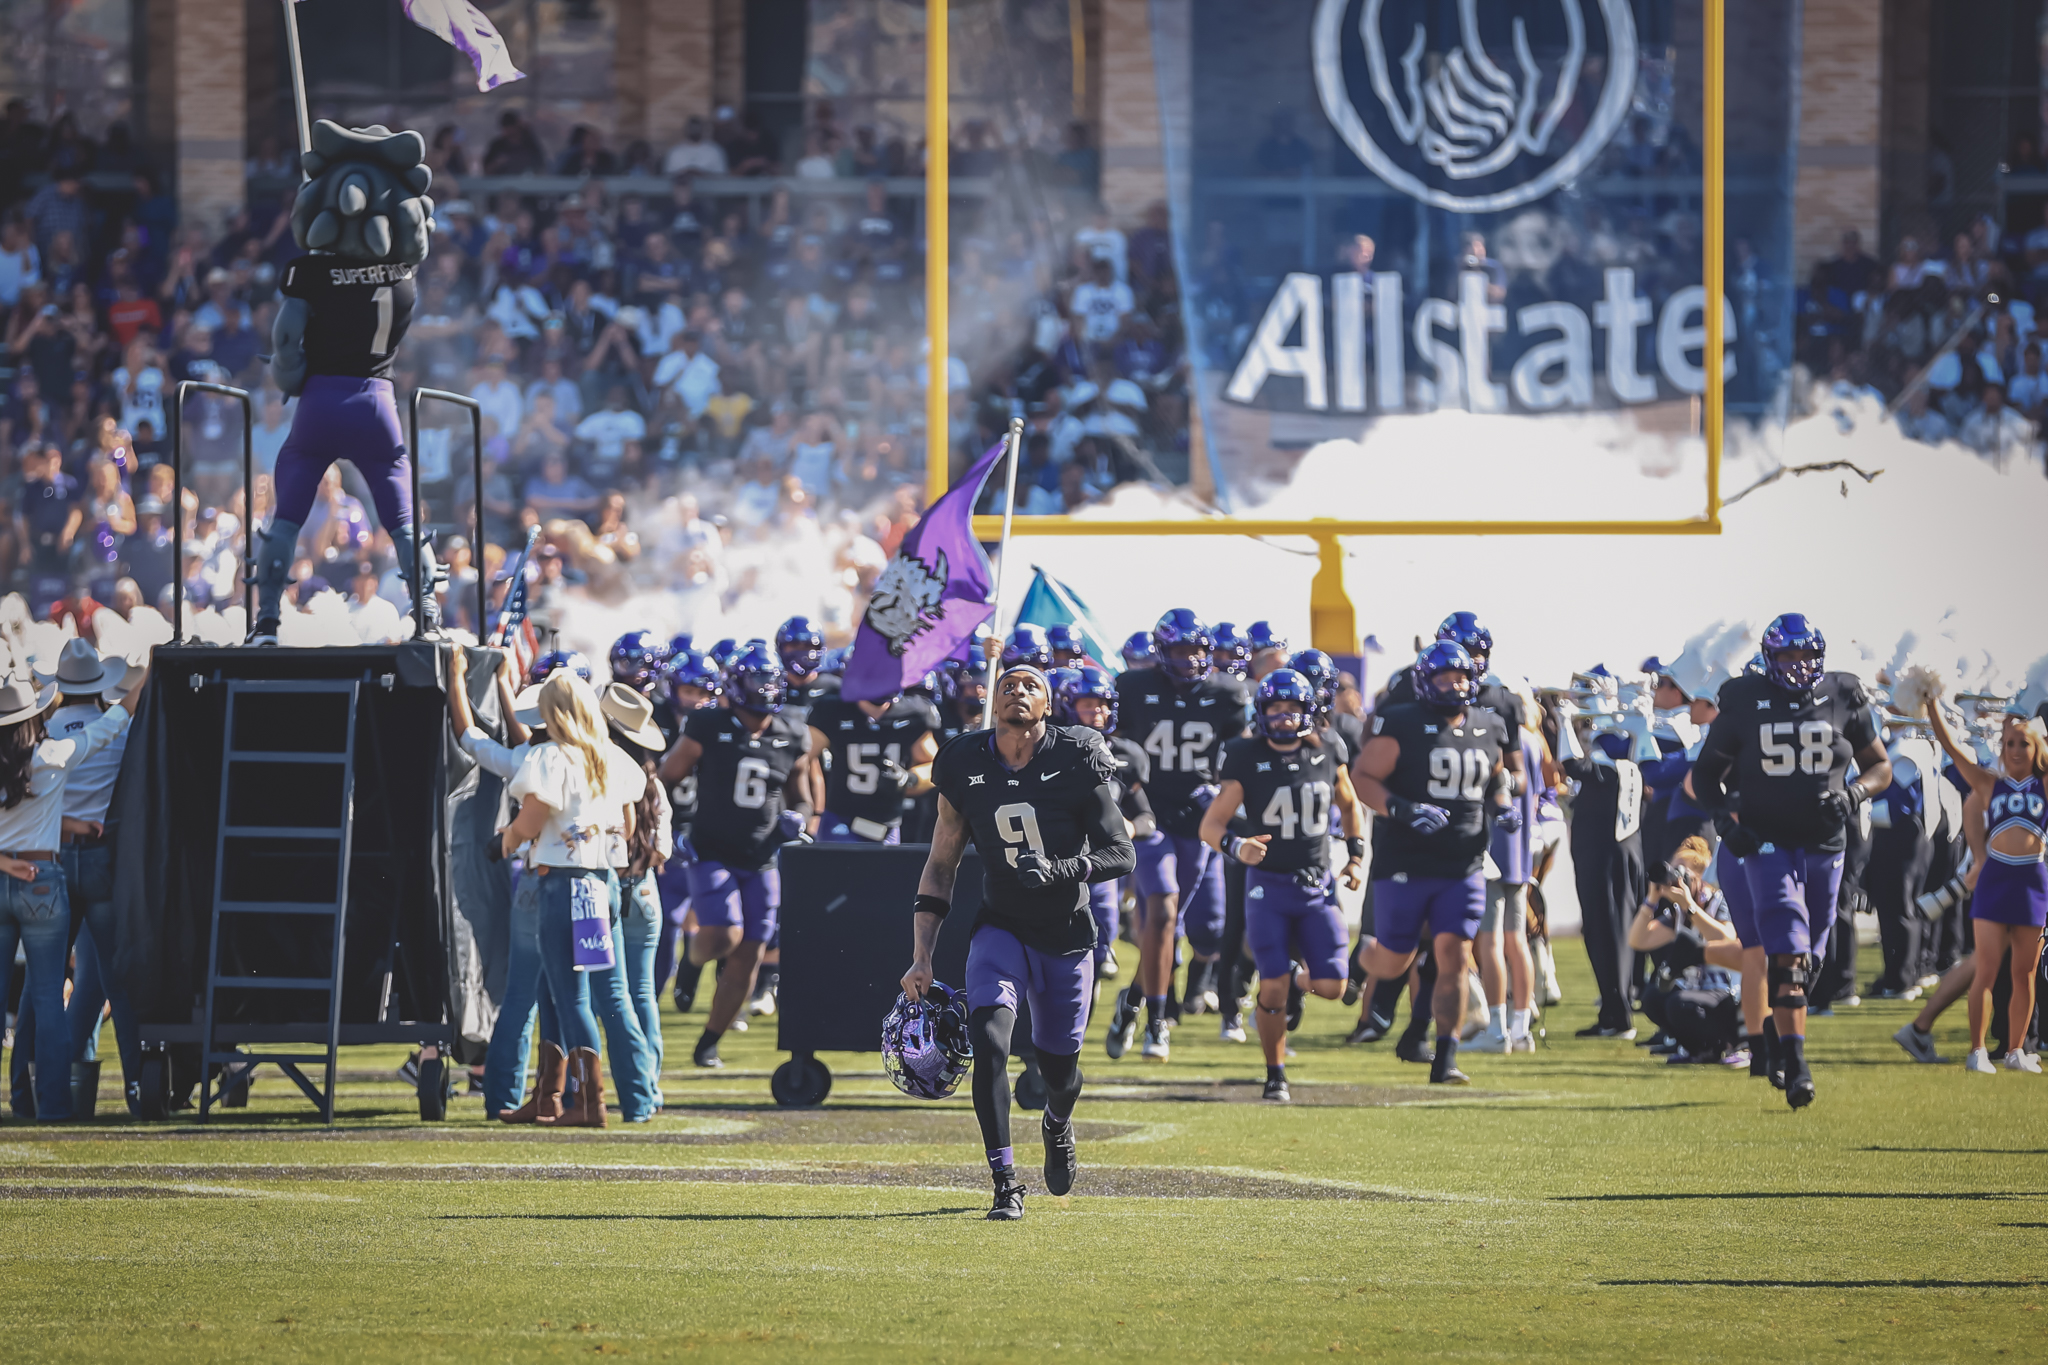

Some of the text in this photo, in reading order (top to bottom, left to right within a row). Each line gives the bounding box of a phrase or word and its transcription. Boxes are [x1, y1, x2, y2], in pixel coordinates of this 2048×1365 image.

[370, 286, 394, 355] 1
[1225, 266, 1739, 414] Allstate
[1144, 719, 1214, 772] 42
[1426, 747, 1491, 801] 90
[1759, 720, 1834, 777] 58
[733, 756, 771, 809] 6
[1261, 780, 1331, 840] 40
[1990, 792, 2045, 821] TCU
[994, 802, 1046, 869] 9
